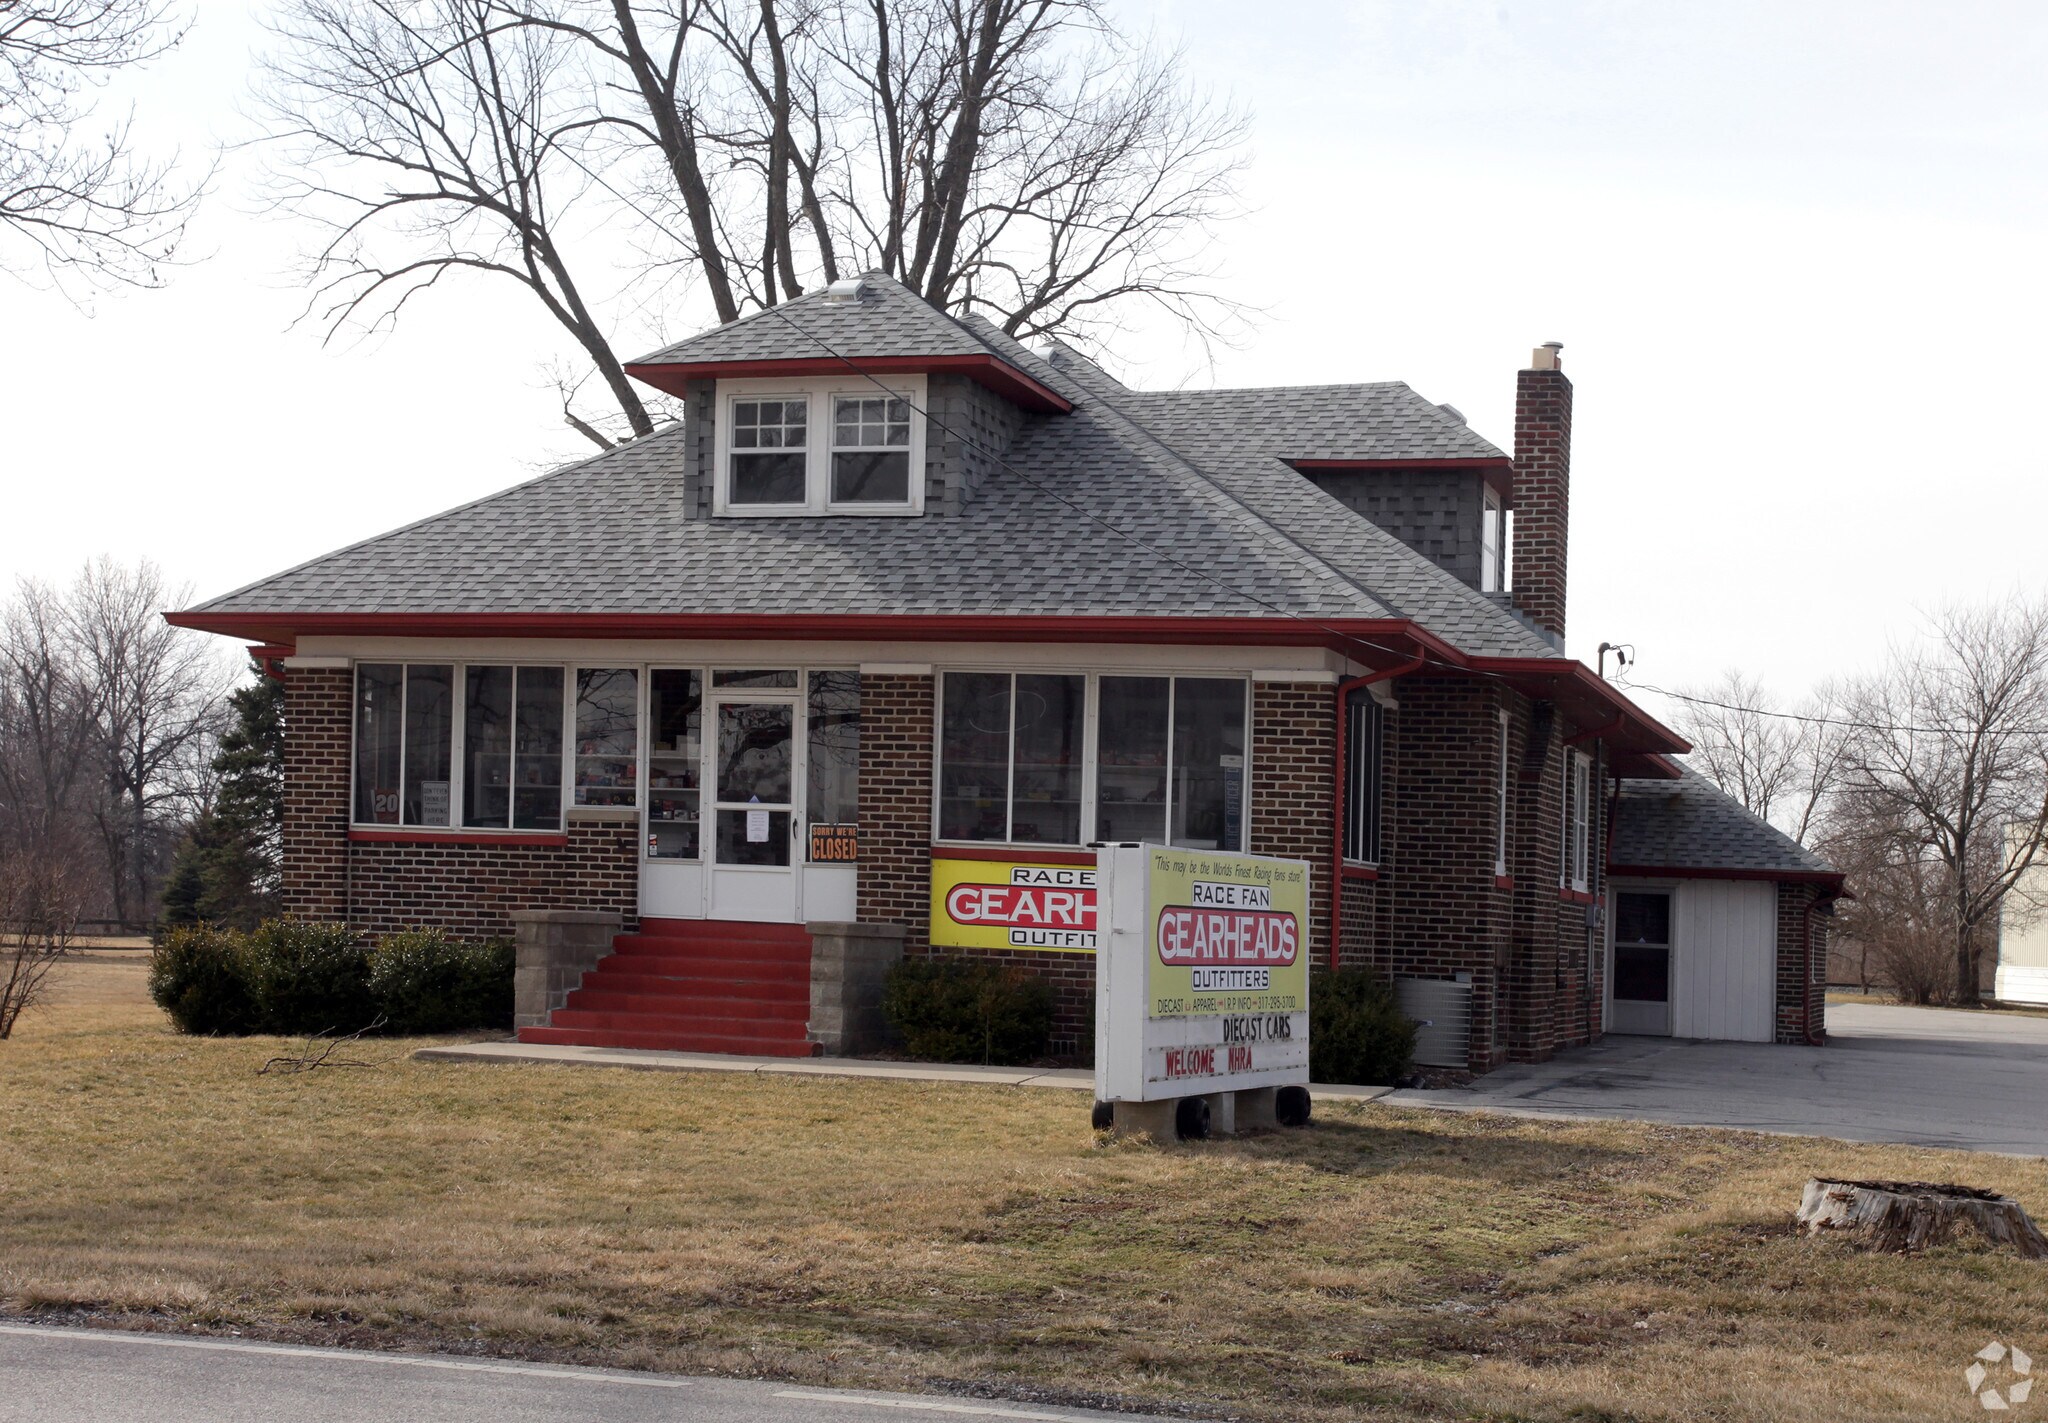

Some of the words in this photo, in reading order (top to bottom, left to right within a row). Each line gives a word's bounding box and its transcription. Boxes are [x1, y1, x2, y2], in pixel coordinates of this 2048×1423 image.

[376, 794, 398, 813] 20
[1227, 780, 1239, 816] OFFICER
[813, 827, 834, 835] SORRY
[836, 827, 856, 836] WE'RE
[812, 838, 857, 860] CLOSED
[1014, 869, 1096, 885] RACE
[1173, 862, 1187, 878] may
[1190, 862, 1197, 873] be
[1200, 862, 1210, 875] the
[1213, 862, 1232, 877] Worlds
[1235, 864, 1252, 878] Finest
[1254, 866, 1272, 885] Racing
[1274, 868, 1286, 882] fans
[1194, 885, 1235, 904] RACE
[1242, 889, 1270, 907] FAN
[1159, 912, 1296, 960] GEARHEADS
[1193, 971, 1269, 988] OUTFITTERS
[1158, 999, 1184, 1013] DIECAST
[1193, 998, 1217, 1012] APPAREL
[1238, 997, 1251, 1010] INFO
[1258, 996, 1296, 1010] 317-295-3700
[1223, 1016, 1262, 1042] DIECAST
[1266, 1016, 1291, 1039] CARS
[1166, 1048, 1215, 1077] WELCOME
[1228, 1046, 1252, 1071] NHRA
